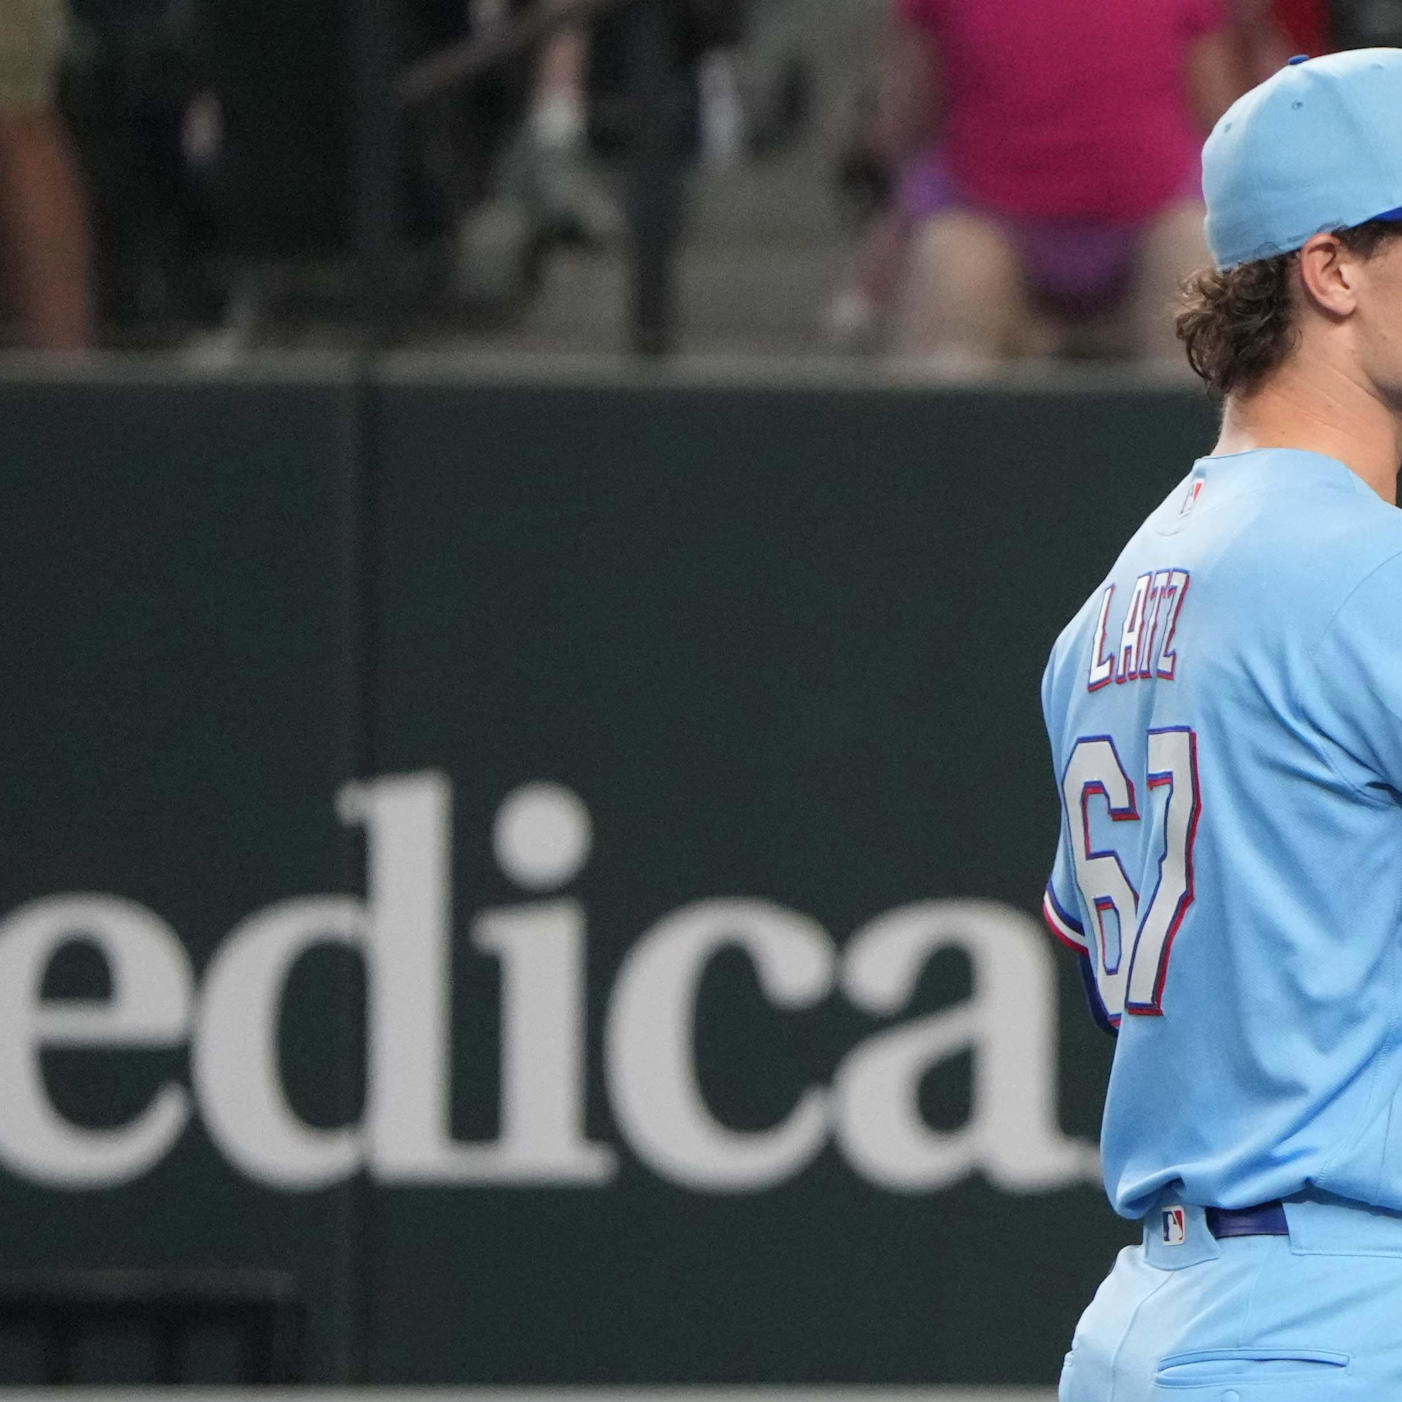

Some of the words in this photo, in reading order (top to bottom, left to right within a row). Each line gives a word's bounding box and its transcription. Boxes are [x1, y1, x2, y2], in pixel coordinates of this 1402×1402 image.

[1088, 568, 1190, 692] LATZ
[0, 767, 1104, 1194] edica
[1062, 725, 1202, 1028] 67
